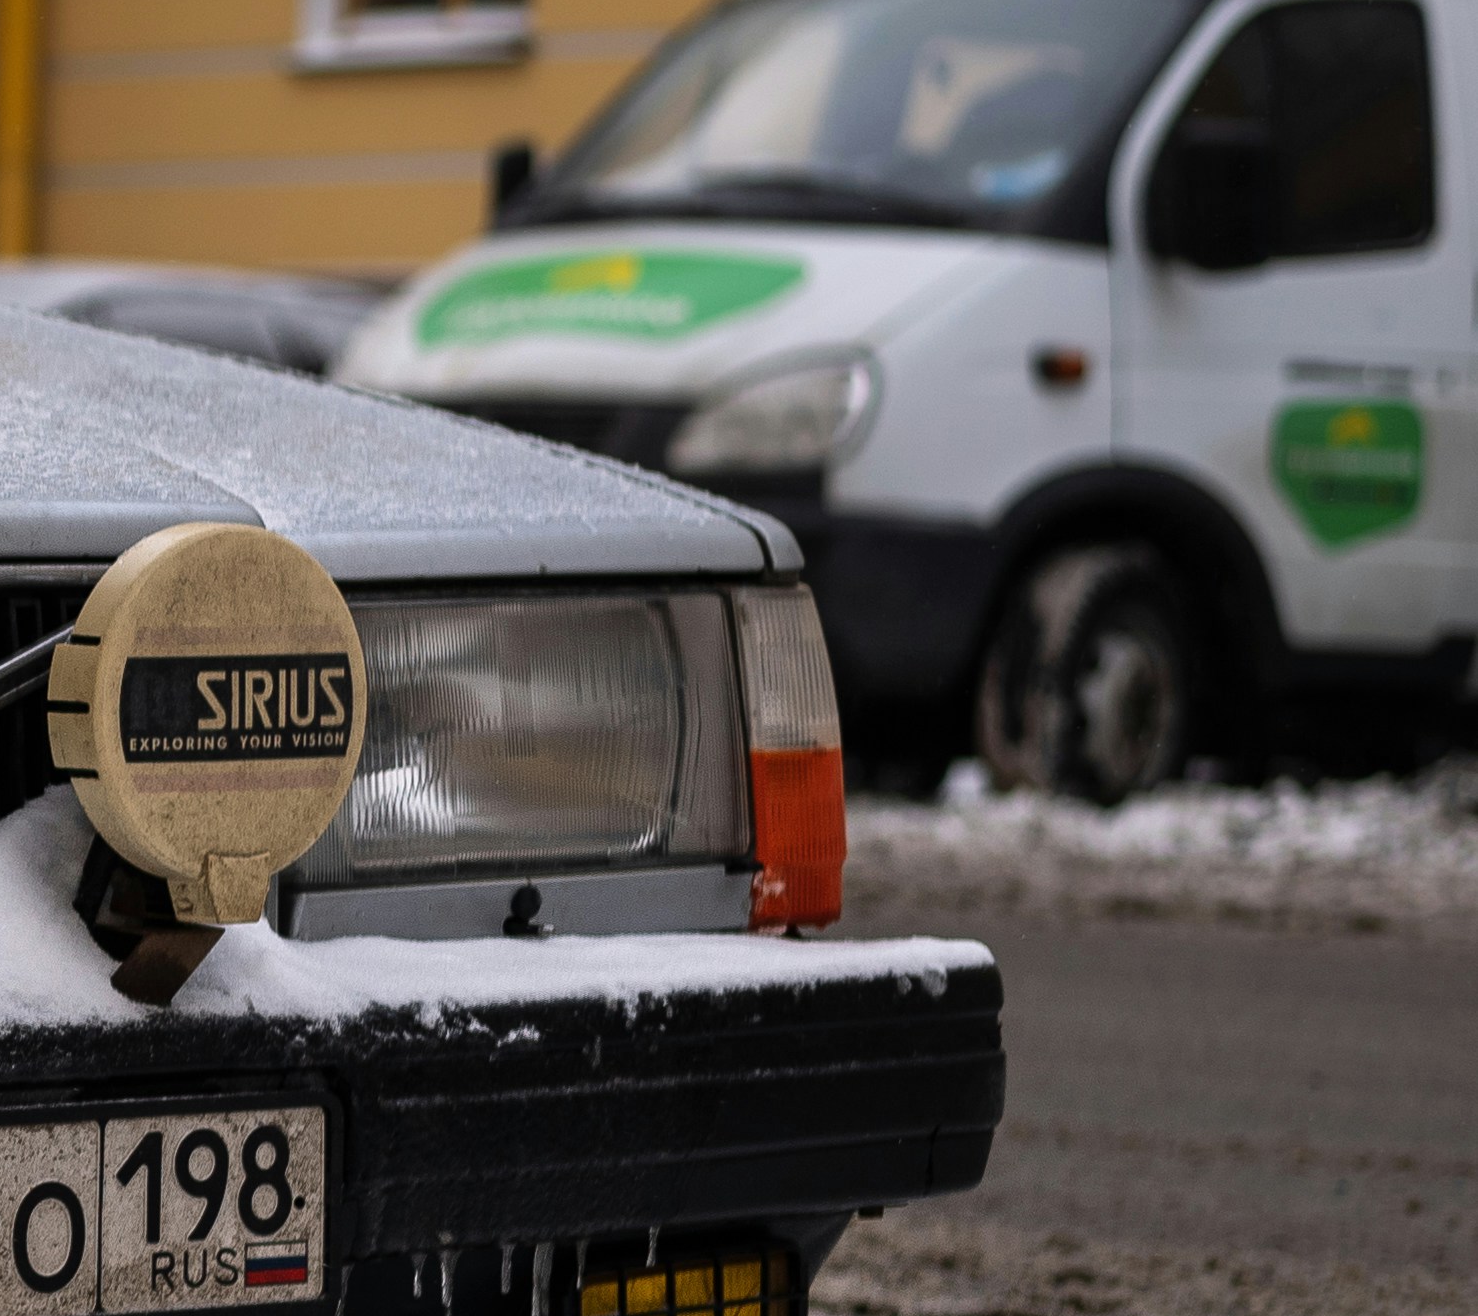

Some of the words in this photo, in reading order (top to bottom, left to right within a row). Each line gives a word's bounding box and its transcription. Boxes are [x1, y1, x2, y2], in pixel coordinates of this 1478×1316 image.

[197, 668, 345, 730] SIRIUS
[129, 735, 228, 752] EXPLORING
[239, 734, 282, 749] YOUR
[292, 732, 344, 747] VISION
[116, 1124, 293, 1245] 198
[151, 1247, 239, 1292] RUS
